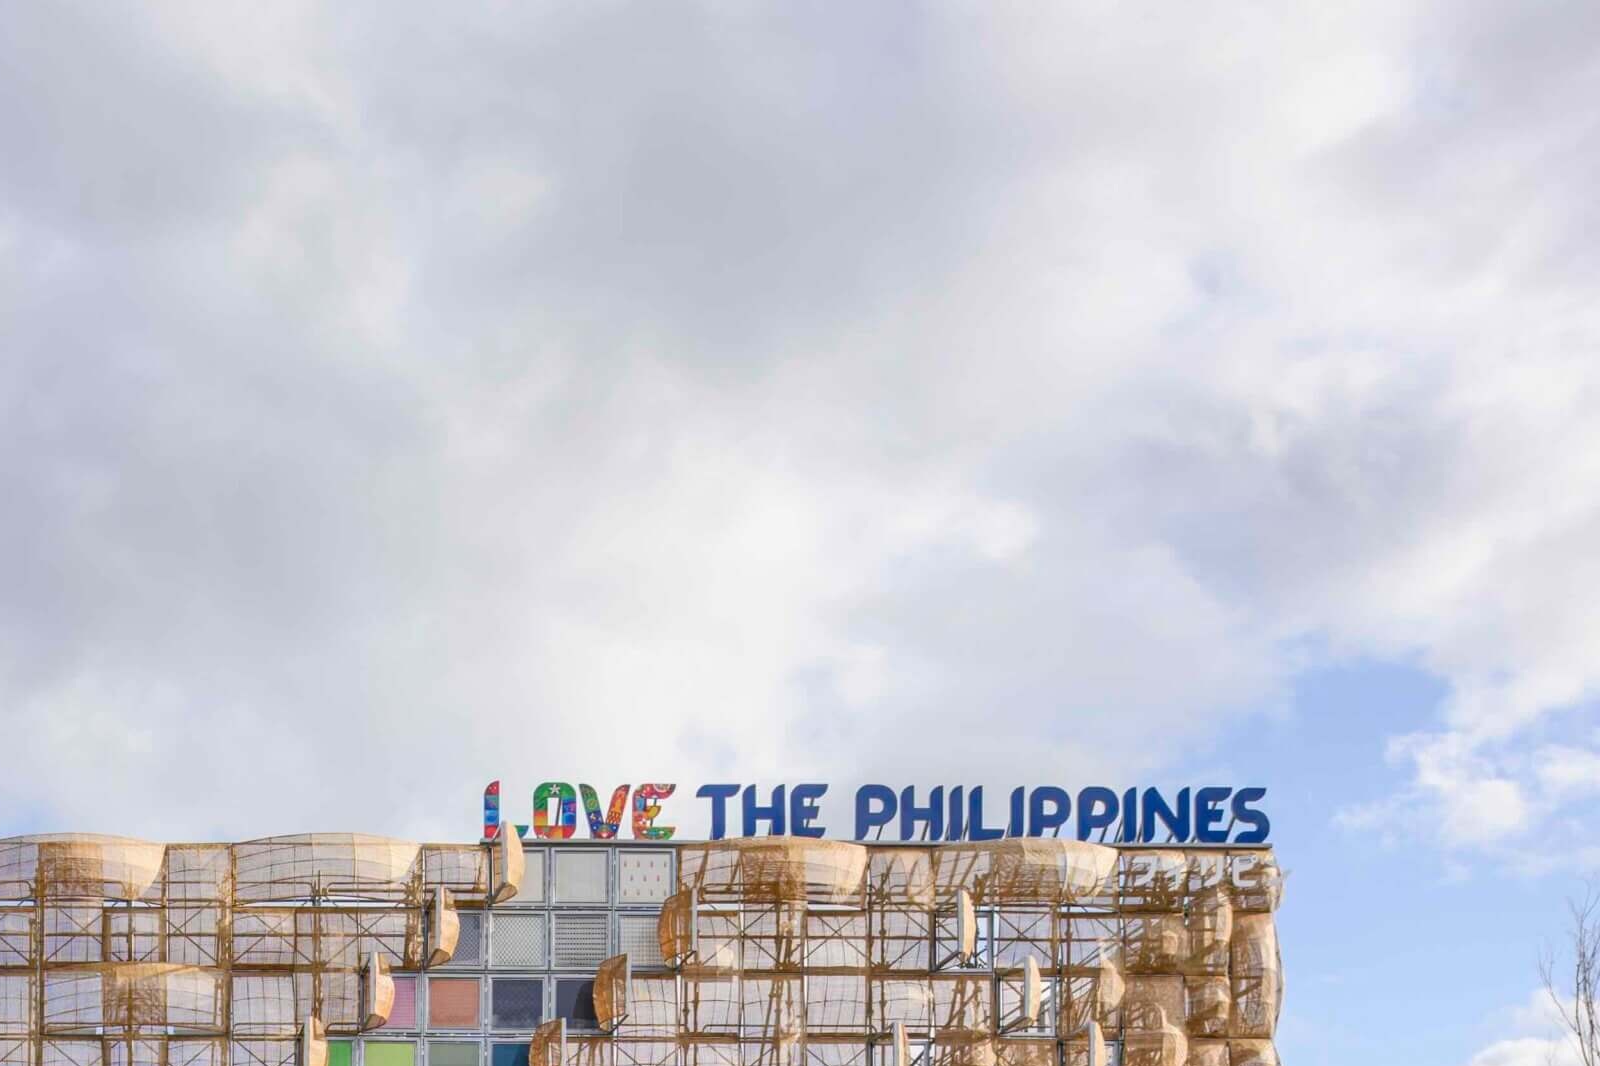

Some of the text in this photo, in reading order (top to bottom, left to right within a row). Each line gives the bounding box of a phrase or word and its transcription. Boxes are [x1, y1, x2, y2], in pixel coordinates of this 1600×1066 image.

[484, 780, 1271, 843] LOVE THE PHILIPPINES
